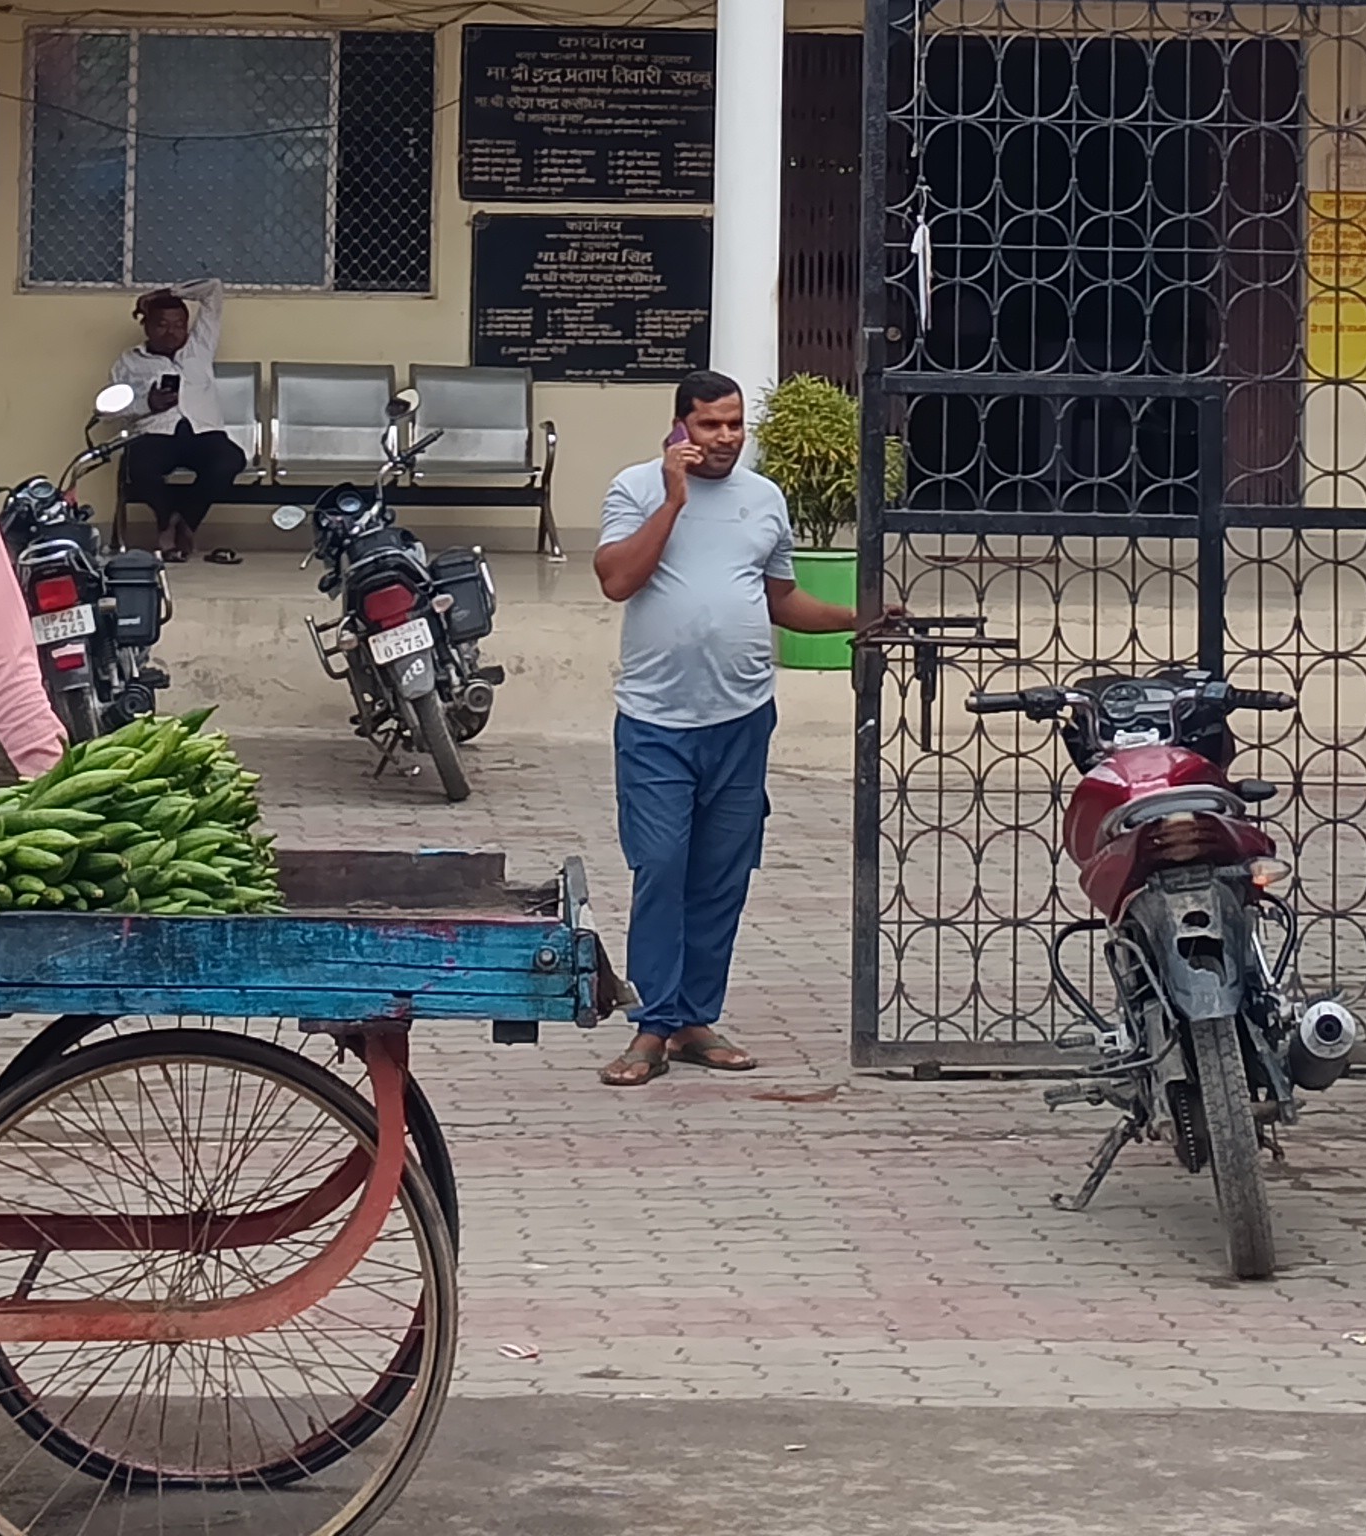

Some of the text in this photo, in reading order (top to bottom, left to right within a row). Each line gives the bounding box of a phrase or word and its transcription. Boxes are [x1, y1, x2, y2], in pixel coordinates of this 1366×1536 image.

[558, 34, 646, 50] कार्यालय
[511, 63, 530, 82] श्री
[564, 66, 608, 83] प्रताप
[611, 64, 663, 85] तिवारी
[41, 609, 83, 626] UP42A
[43, 622, 86, 640] E2243
[384, 635, 424, 659] 0575
